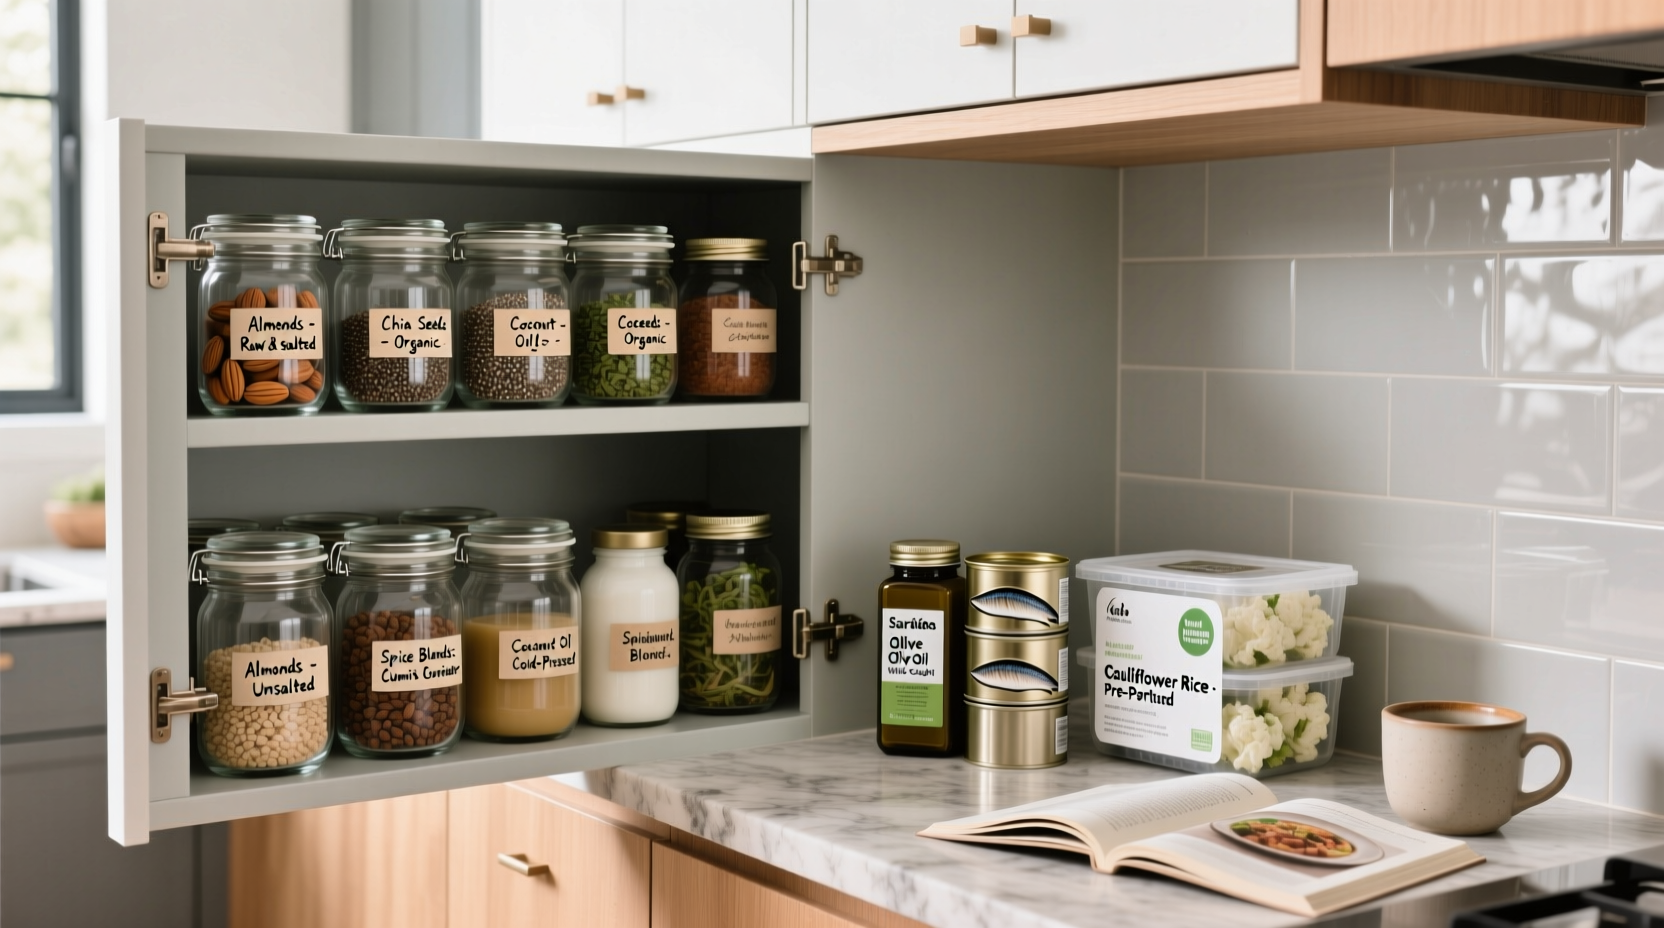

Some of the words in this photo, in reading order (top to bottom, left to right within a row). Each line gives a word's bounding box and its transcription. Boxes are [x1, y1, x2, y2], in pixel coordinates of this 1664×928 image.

[381, 315, 412, 331] Chia
[394, 335, 441, 355] Organic
[624, 332, 667, 350] Organic
[244, 657, 304, 679] Almonds
[380, 649, 414, 667] Spice
[253, 675, 315, 697] Unsalted
[1104, 664, 1179, 689] Cauliflower
[1181, 674, 1209, 694] Rice
